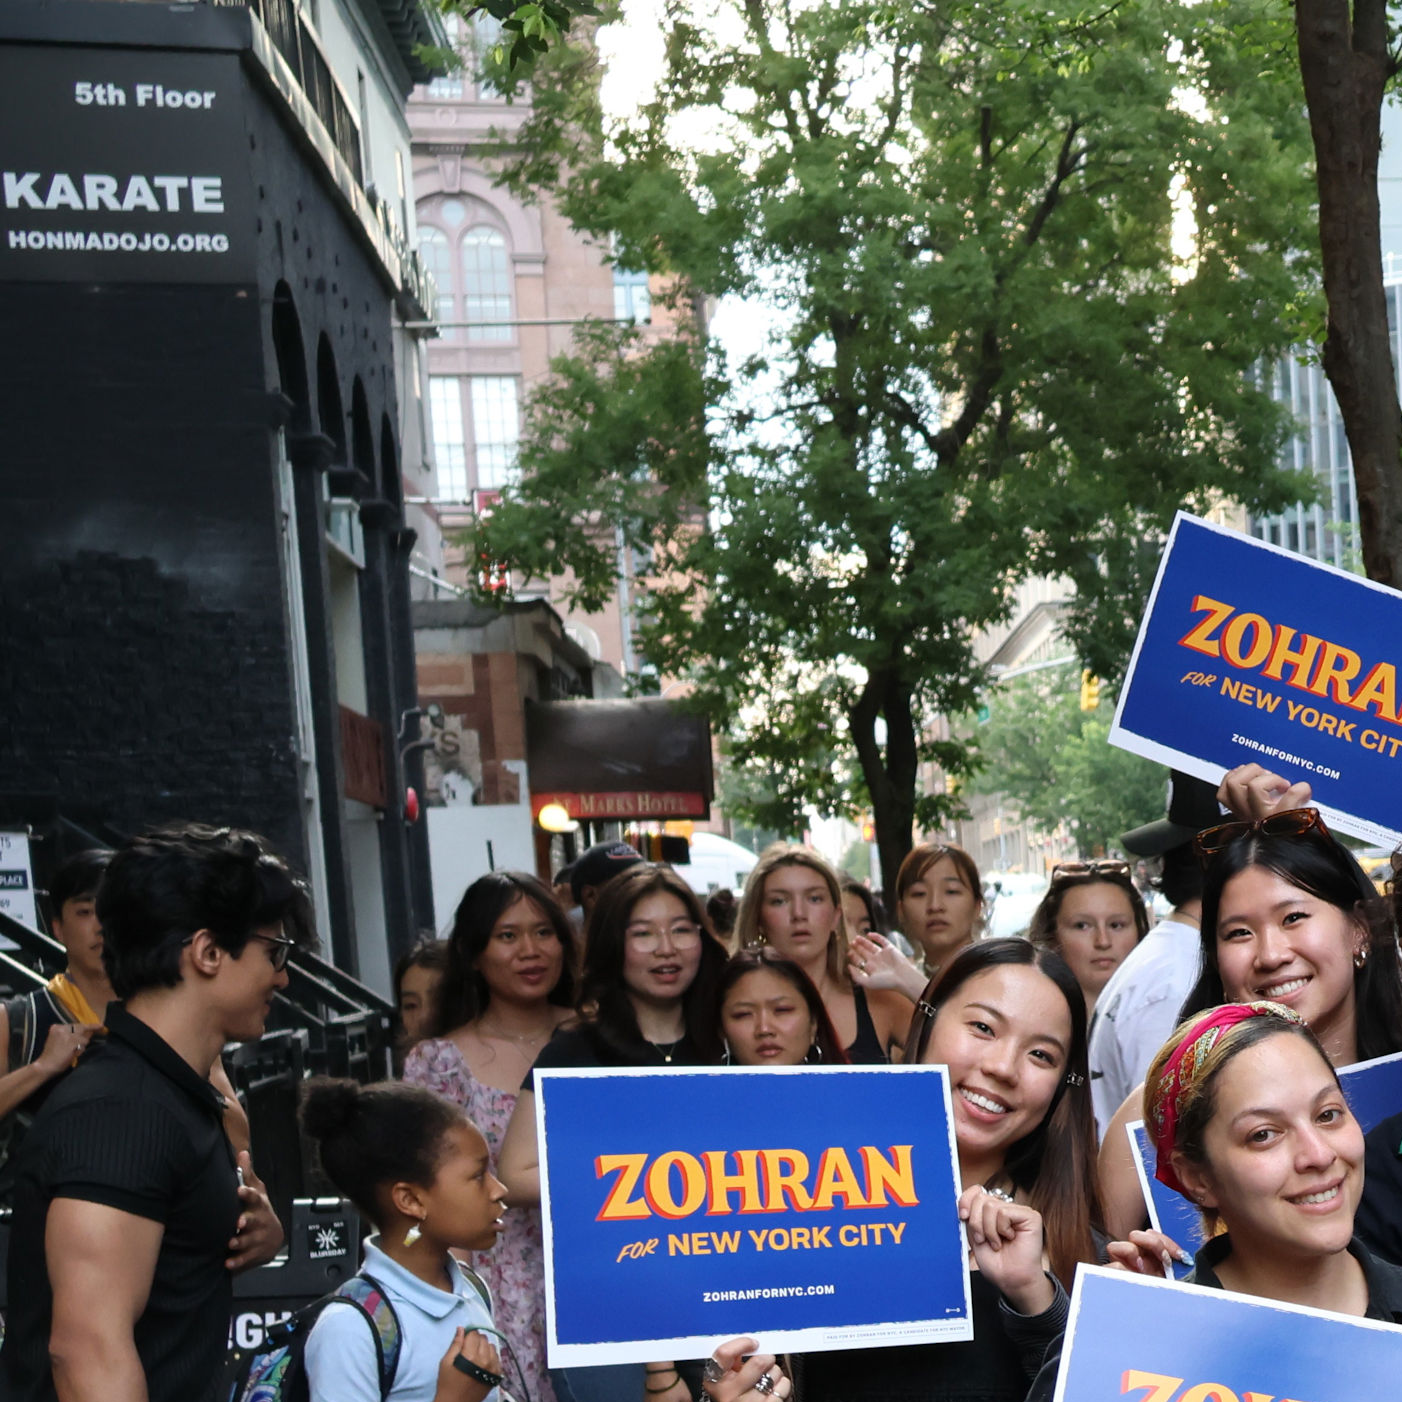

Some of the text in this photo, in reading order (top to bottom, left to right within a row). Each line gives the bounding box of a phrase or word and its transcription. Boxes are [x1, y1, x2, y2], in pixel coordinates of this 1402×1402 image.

[75, 81, 216, 109] 5th Floor
[3, 171, 225, 213] KARATE
[8, 230, 229, 252] HONMADOJO.ORG
[1180, 671, 1216, 688] FOR
[1220, 680, 1280, 713] NEW
[1287, 704, 1358, 743] YORK
[1231, 733, 1340, 780] ZOHRANFORNYC.COM
[595, 1144, 919, 1221] ZOHRAN
[616, 1222, 906, 1263] FOR NEW YORK CITY
[703, 1284, 835, 1303] ZOHRANFORNYC.COM
